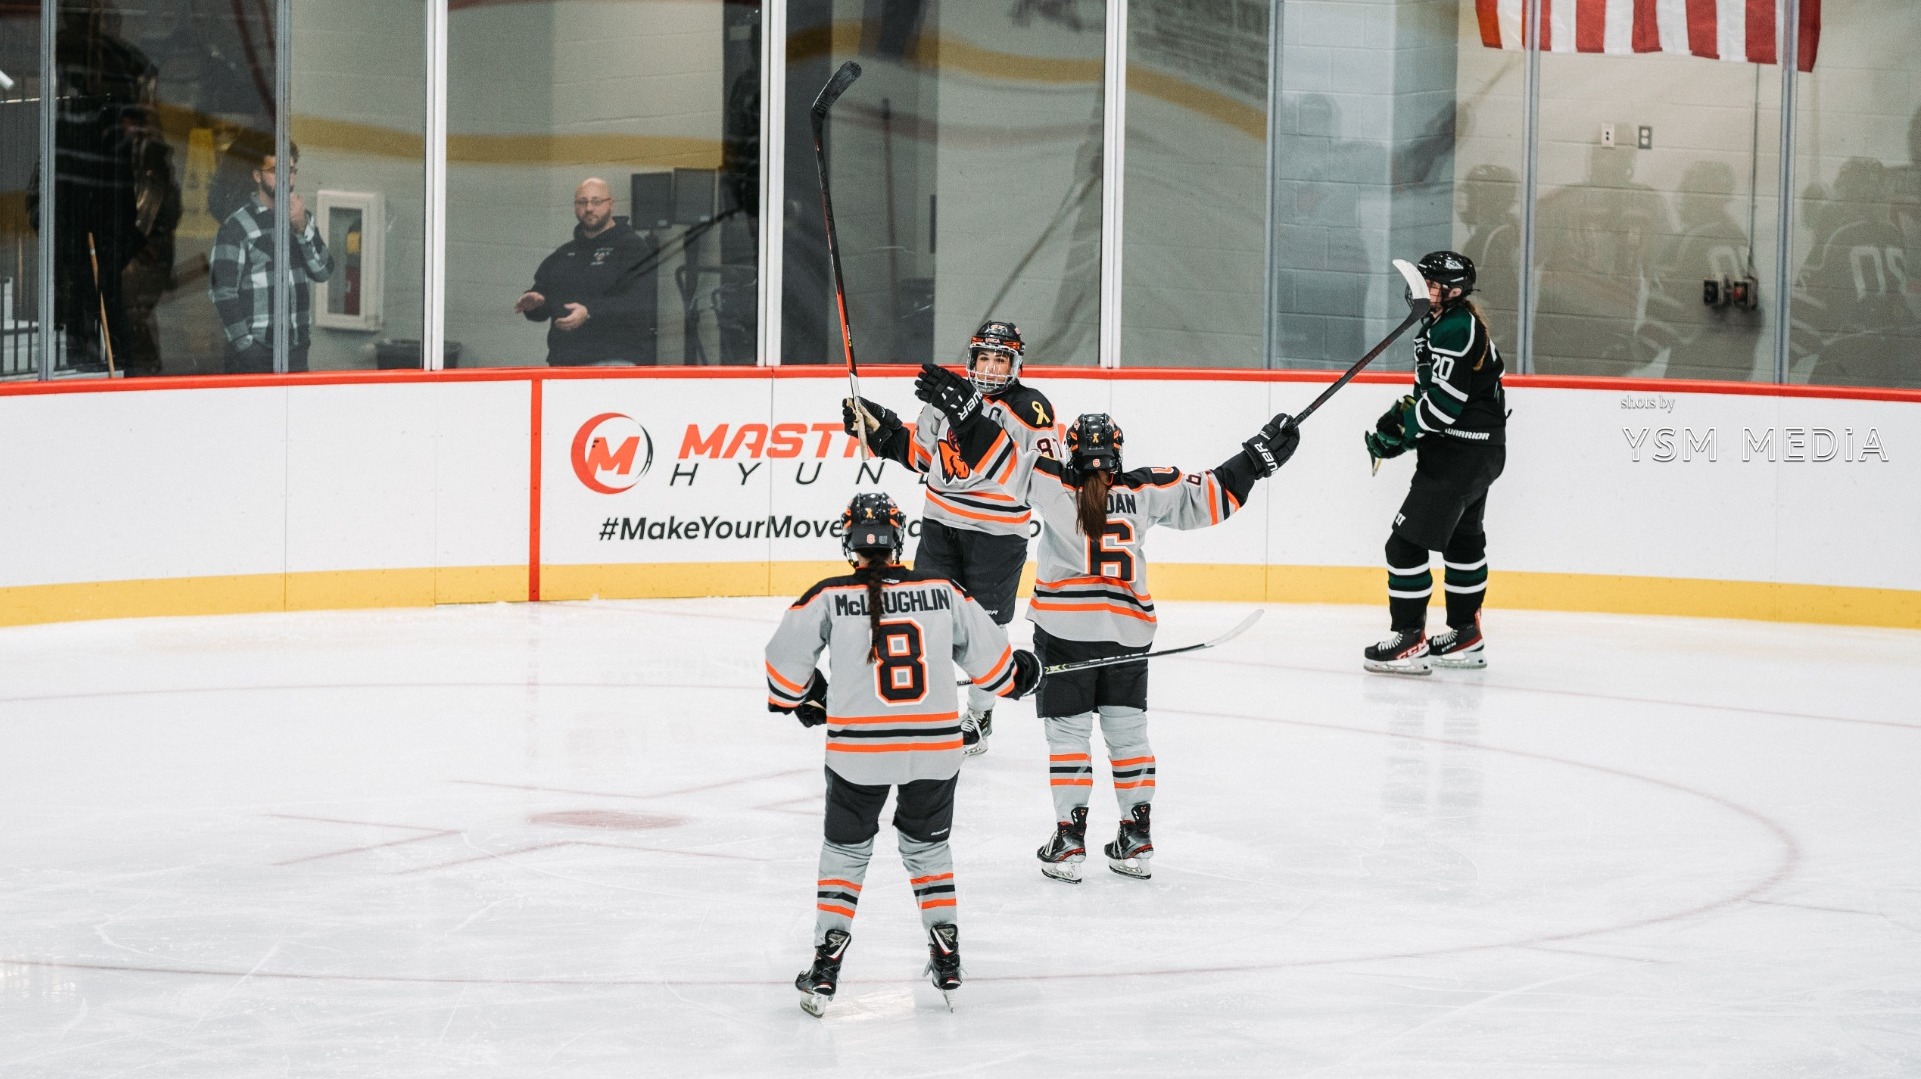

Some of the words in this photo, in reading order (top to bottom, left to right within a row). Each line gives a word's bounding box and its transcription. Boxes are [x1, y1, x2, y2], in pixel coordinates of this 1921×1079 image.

[1431, 353, 1455, 381] 20
[957, 391, 983, 421] UER
[1254, 442, 1279, 473] UER
[669, 461, 927, 486] HYUN
[1105, 494, 1137, 515] DAN
[1085, 518, 1136, 583] 6
[834, 588, 951, 617] McLUGHLIN
[873, 617, 929, 707] 8
